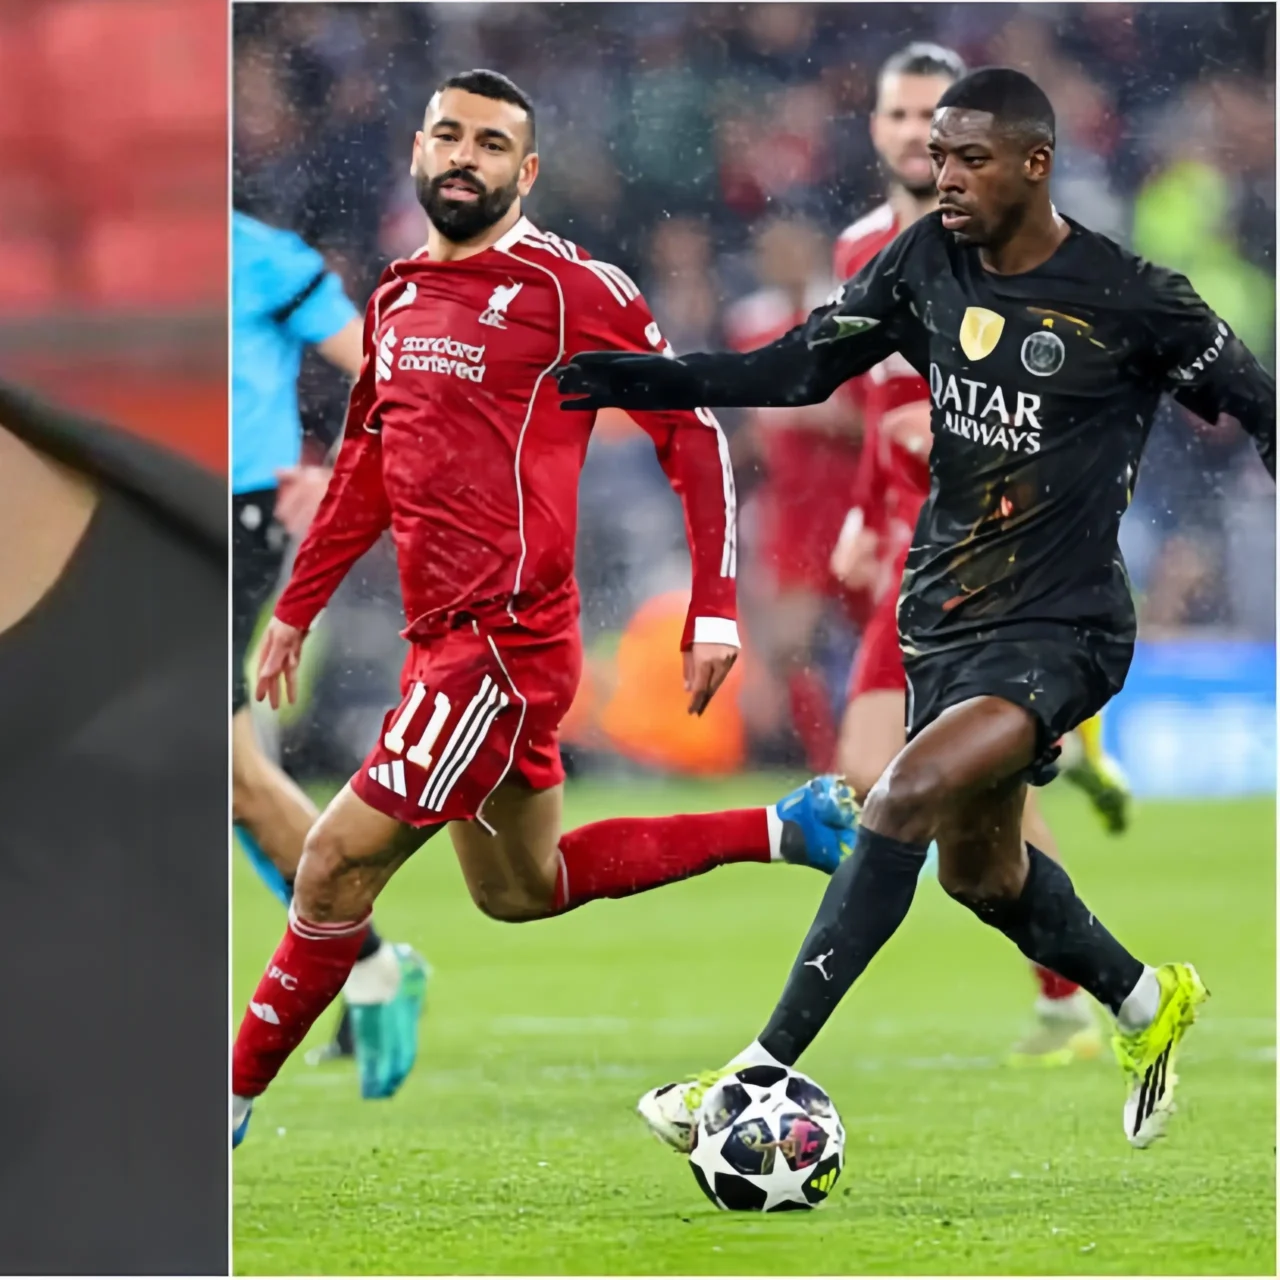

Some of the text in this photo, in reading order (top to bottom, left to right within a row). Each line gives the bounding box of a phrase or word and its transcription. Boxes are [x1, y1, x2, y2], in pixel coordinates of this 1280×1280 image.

[398, 353, 486, 383] chartered
[401, 335, 485, 363] standard
[929, 362, 1043, 429] QATAR
[942, 410, 1041, 455] AIRWAYS
[384, 681, 452, 770] 11
